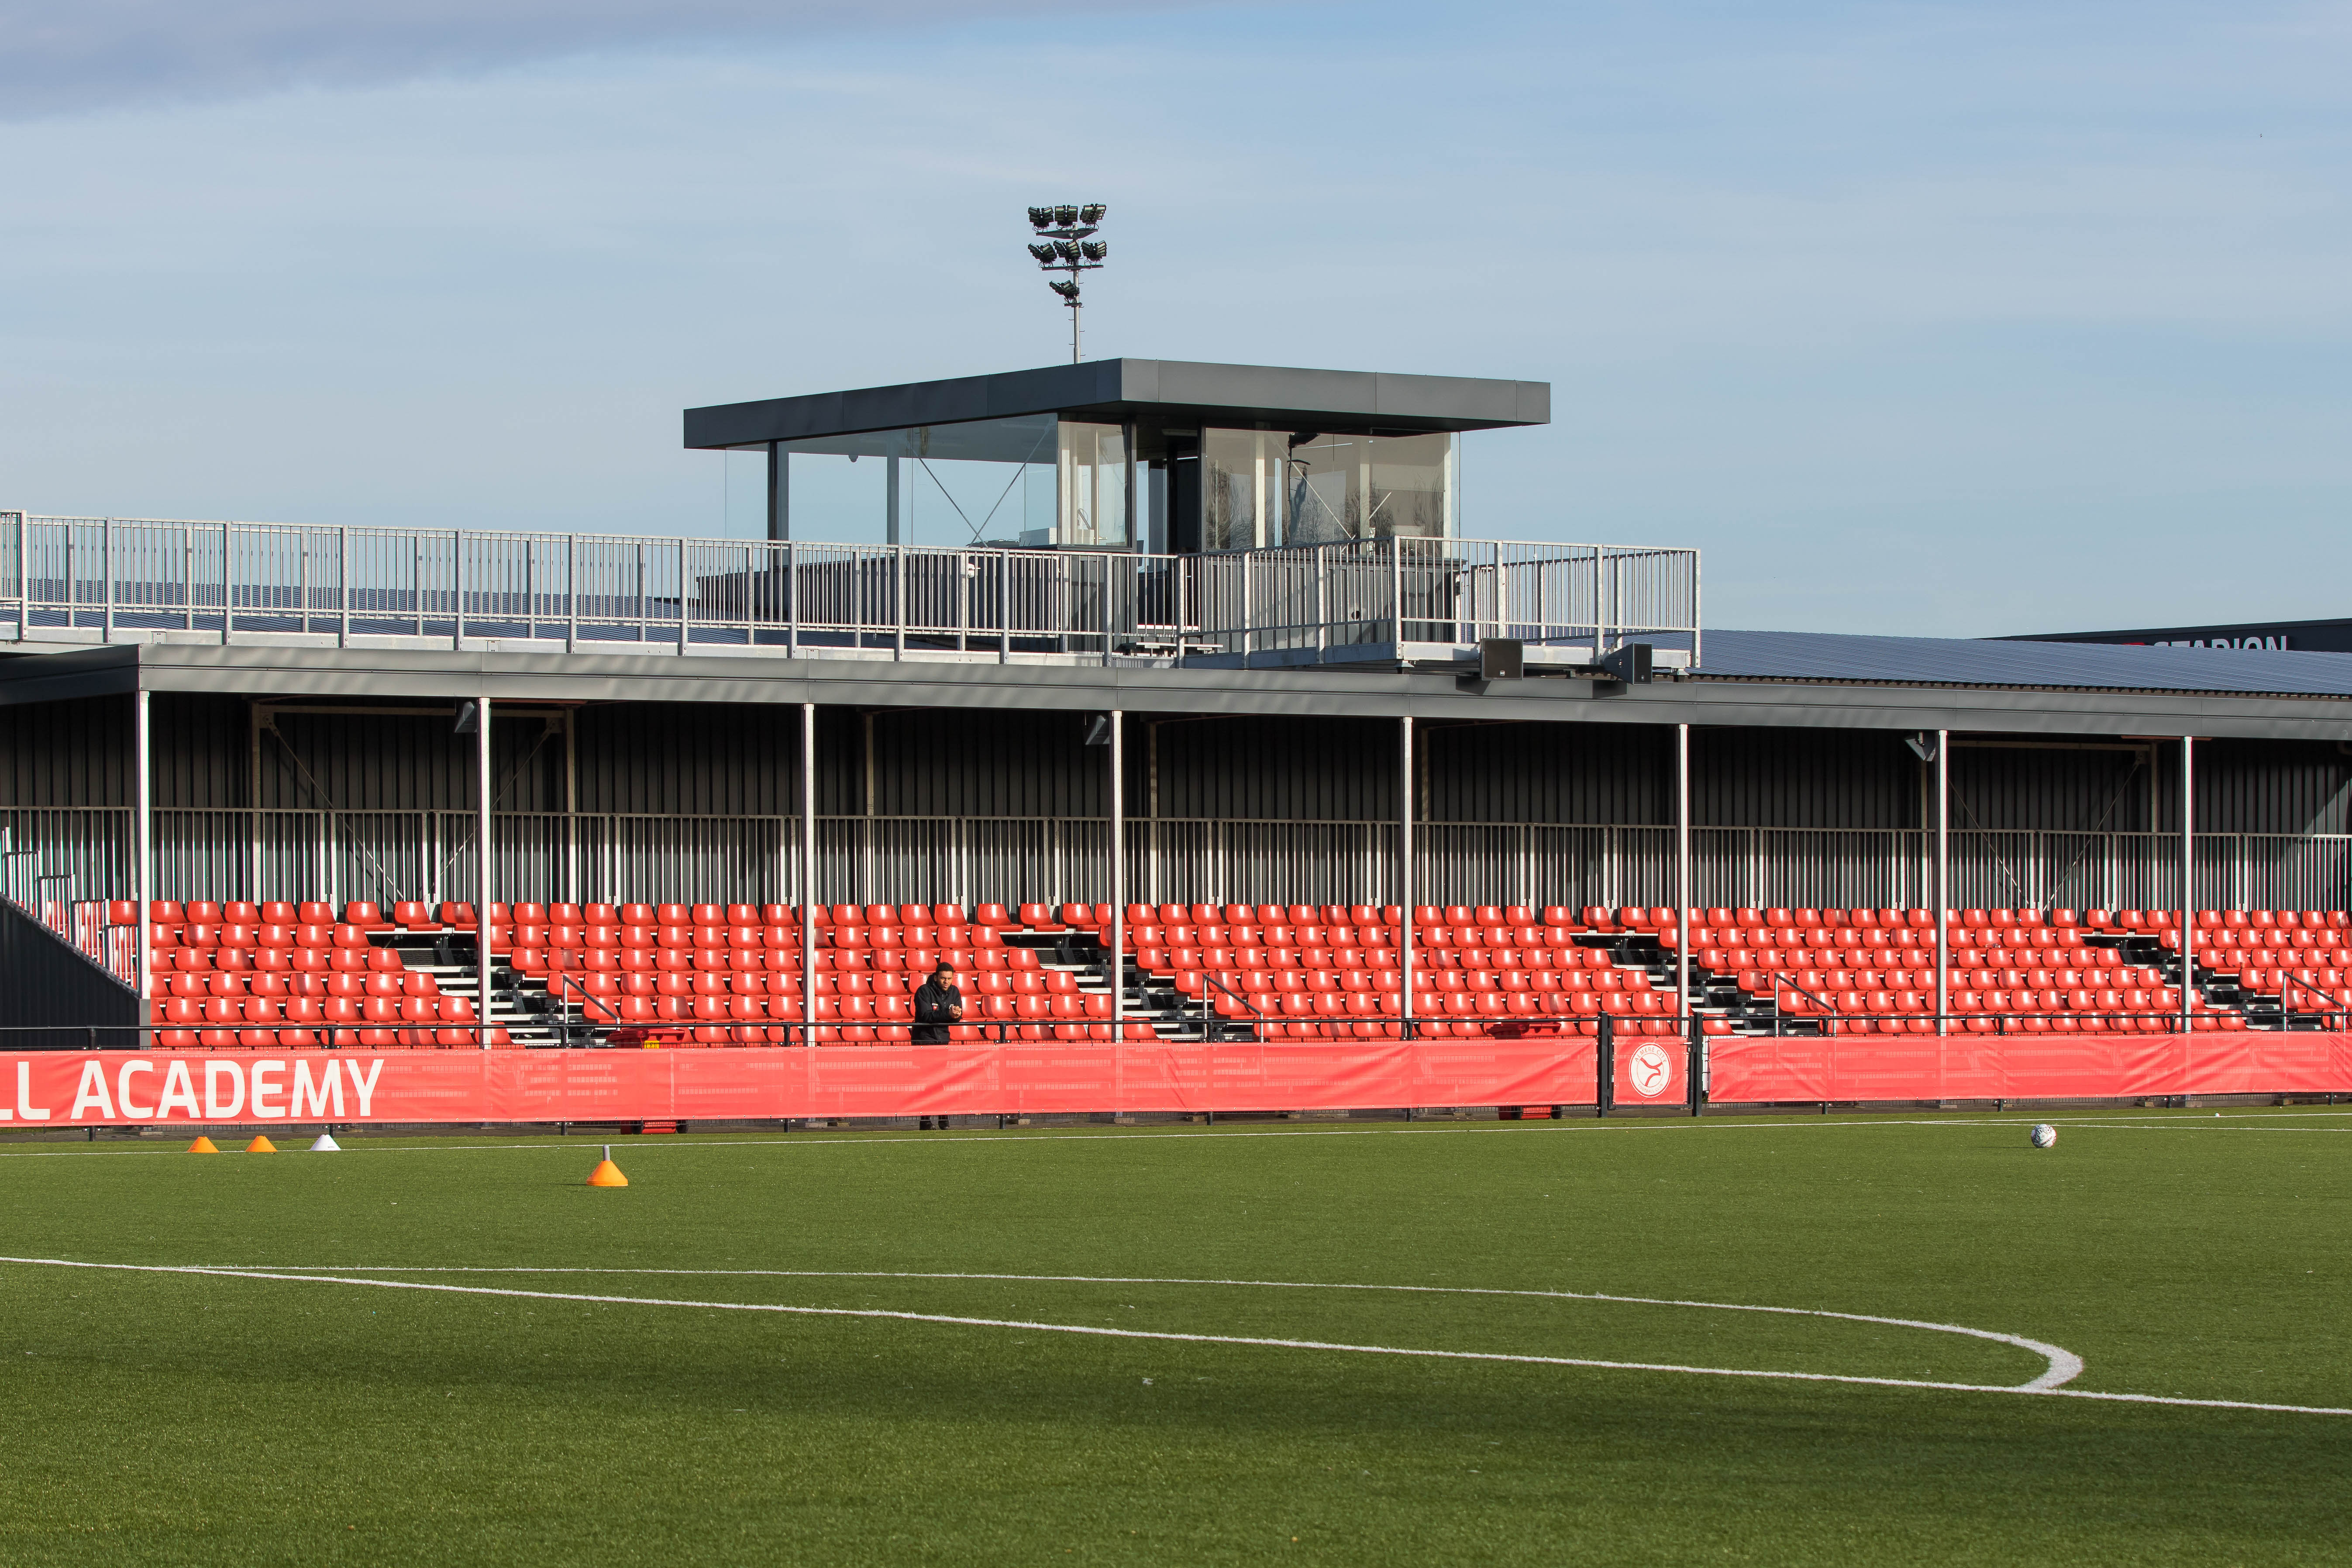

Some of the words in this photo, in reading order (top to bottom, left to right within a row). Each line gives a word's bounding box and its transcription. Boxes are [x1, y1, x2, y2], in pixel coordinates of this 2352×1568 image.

[1635, 1047, 1655, 1062] ALMERE
[1656, 1050, 1667, 1062] CITY
[0, 1061, 50, 1120] L
[70, 1059, 384, 1119] ACADEMY
